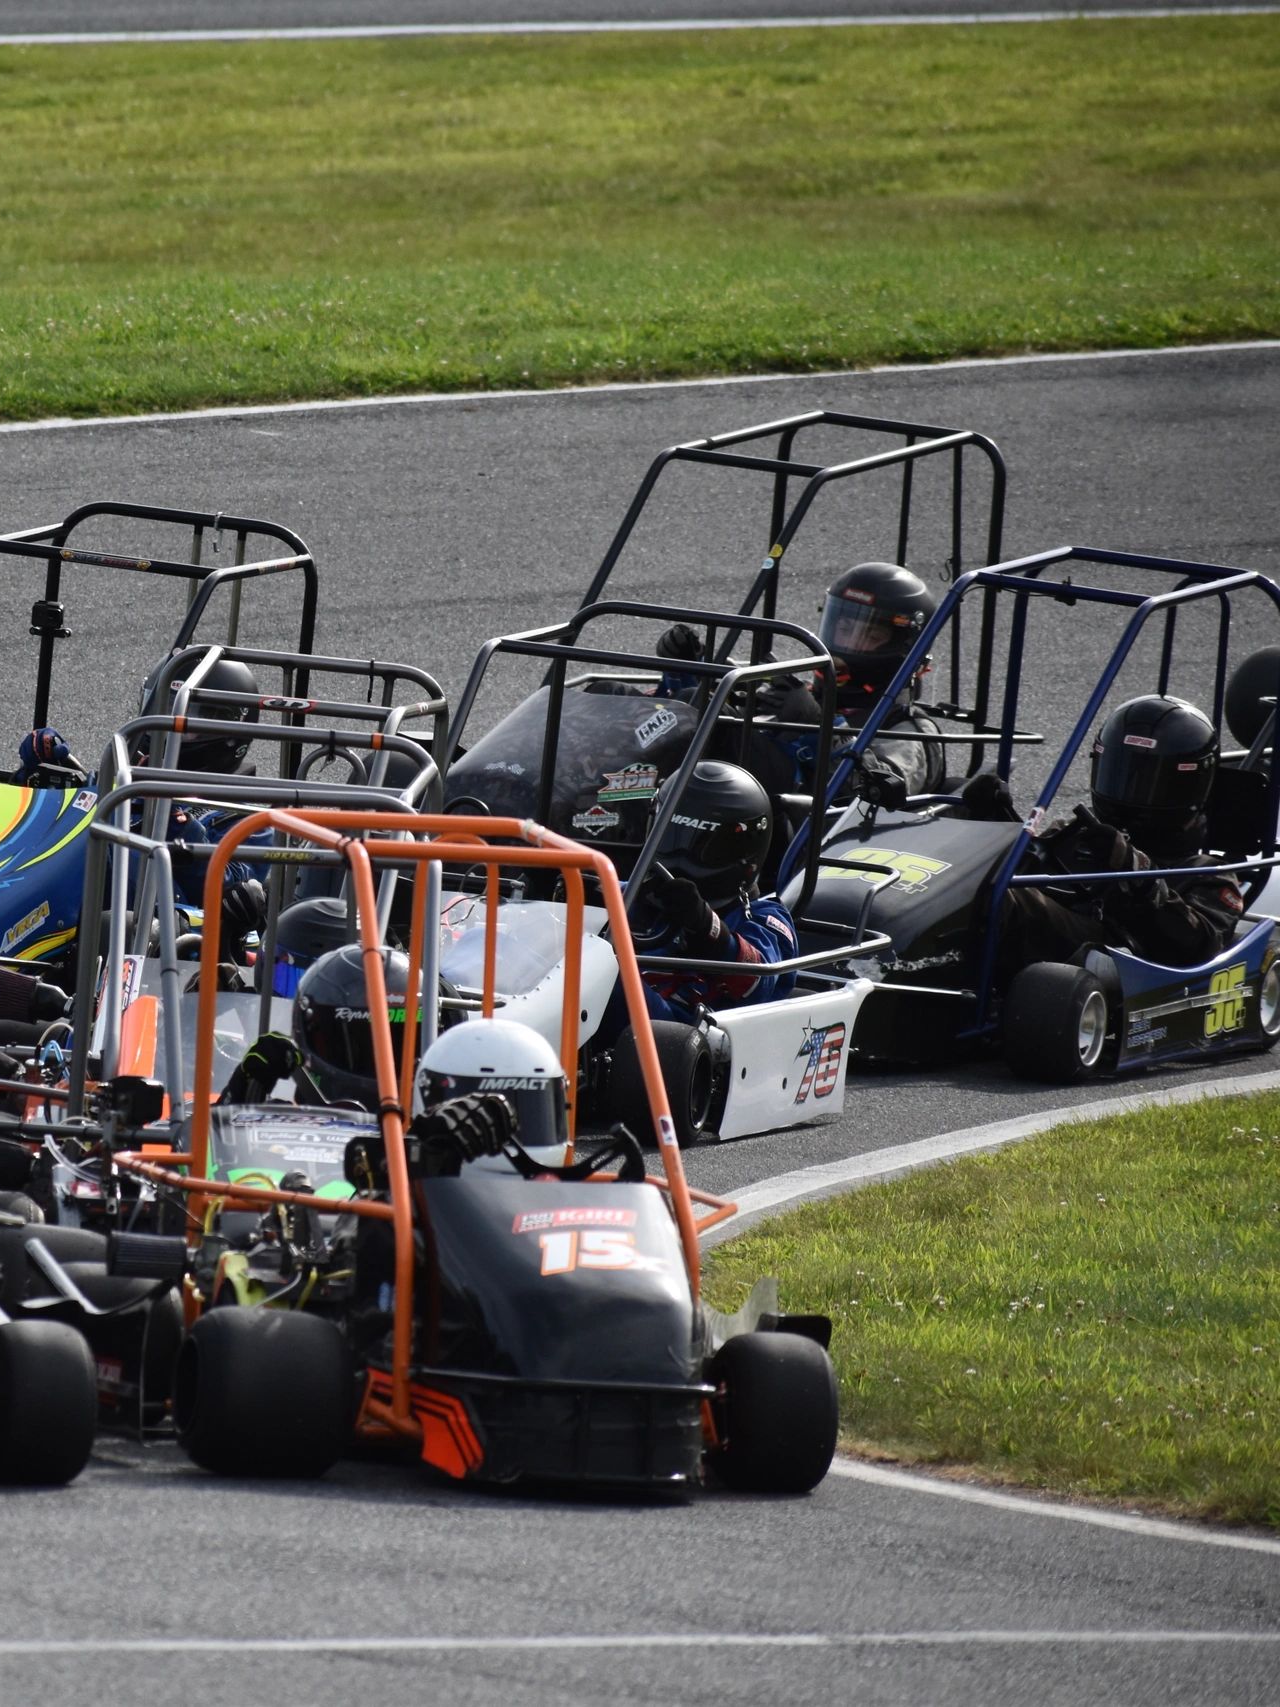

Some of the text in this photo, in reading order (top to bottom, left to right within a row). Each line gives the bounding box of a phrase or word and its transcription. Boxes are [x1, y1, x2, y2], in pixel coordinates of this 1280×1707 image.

[609, 774, 655, 789] RPM
[671, 813, 722, 832] MPACT
[793, 1020, 846, 1105] 76
[478, 1078, 549, 1091] IMPACT
